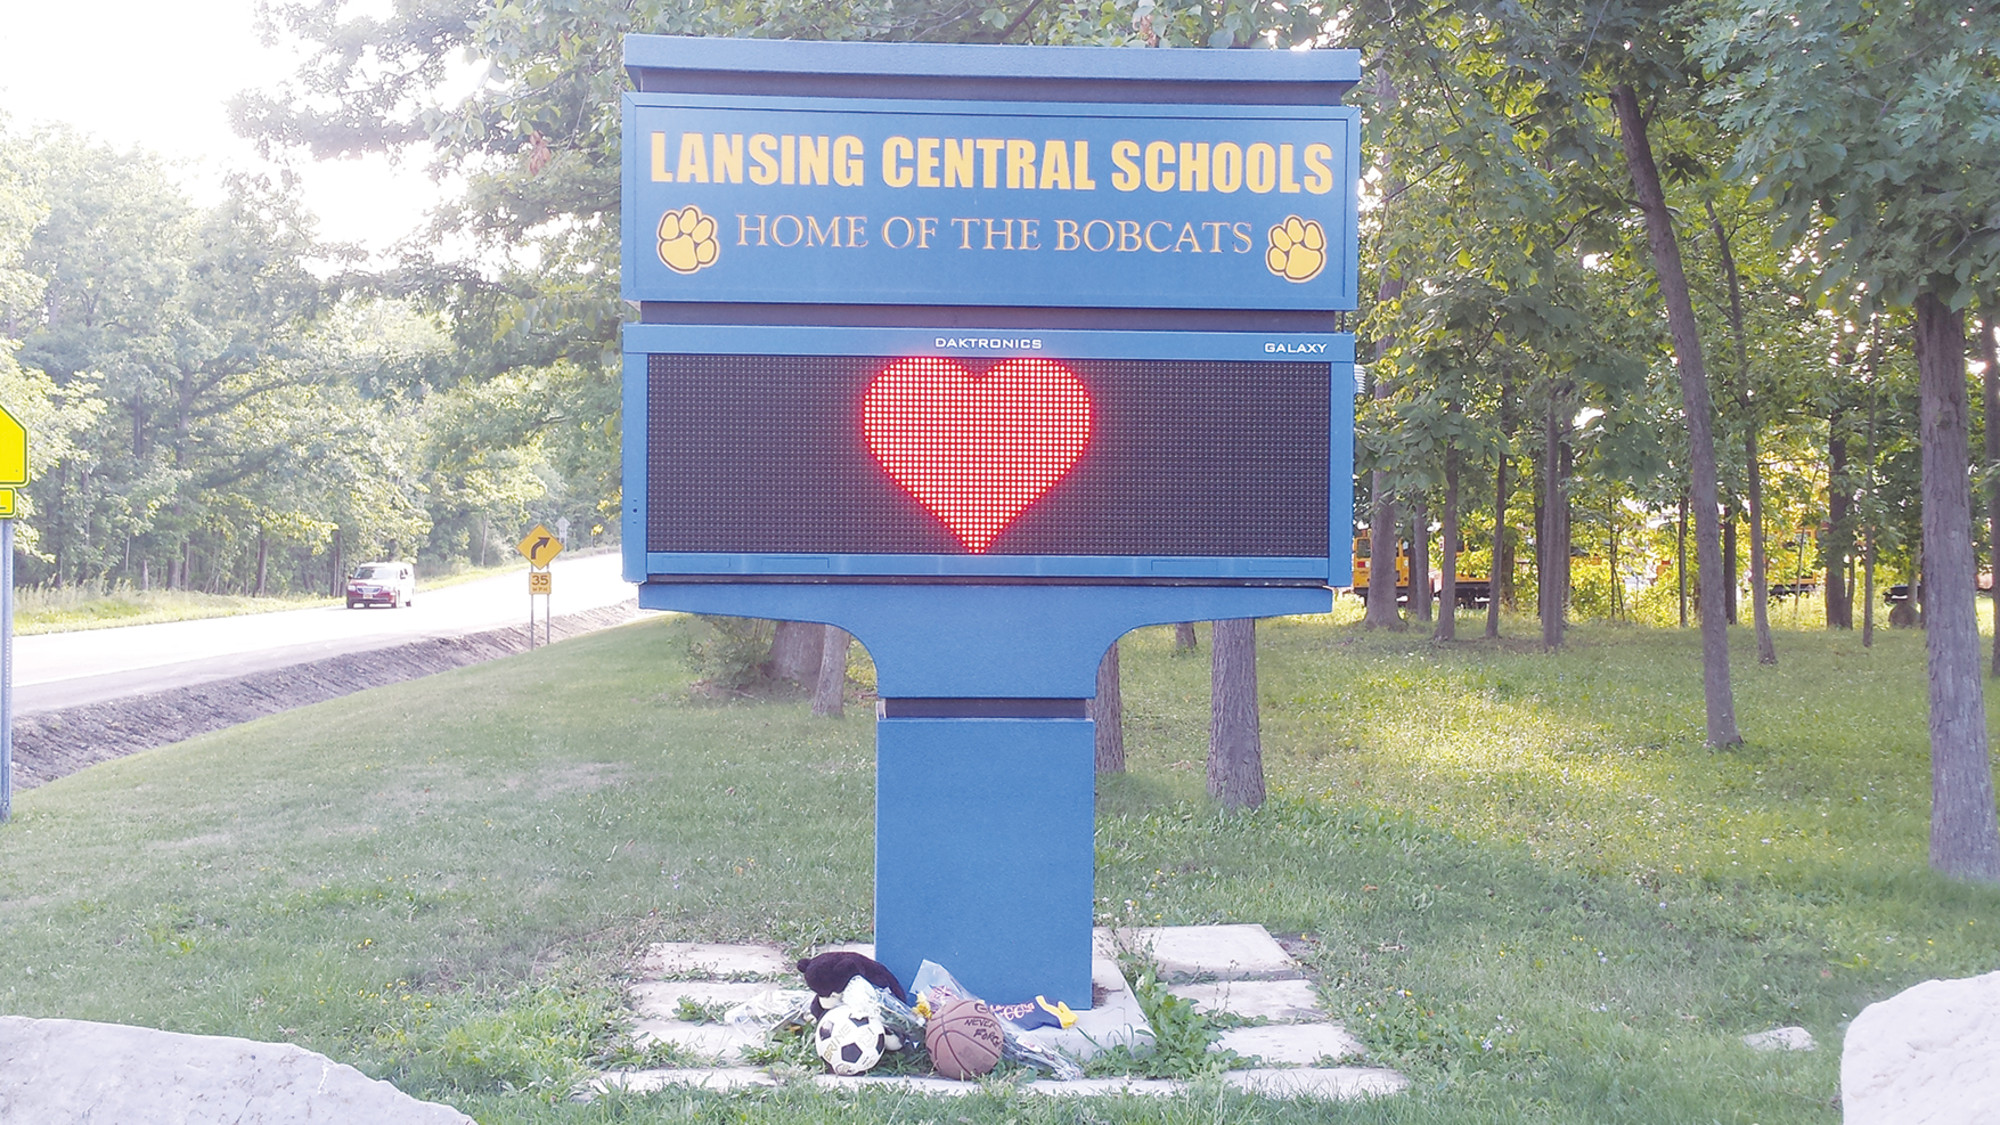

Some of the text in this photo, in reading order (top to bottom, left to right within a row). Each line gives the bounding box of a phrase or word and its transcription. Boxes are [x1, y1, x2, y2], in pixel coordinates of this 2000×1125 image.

[651, 132, 1333, 194] LANSING CENTRAL SCHOOLS
[736, 214, 1253, 253] HOME OF THE BOBCATS
[935, 337, 1042, 349] DAKTRONICS
[1264, 342, 1328, 353] GALAXY
[531, 575, 549, 586] 35
[823, 1023, 851, 1062] BRINE
